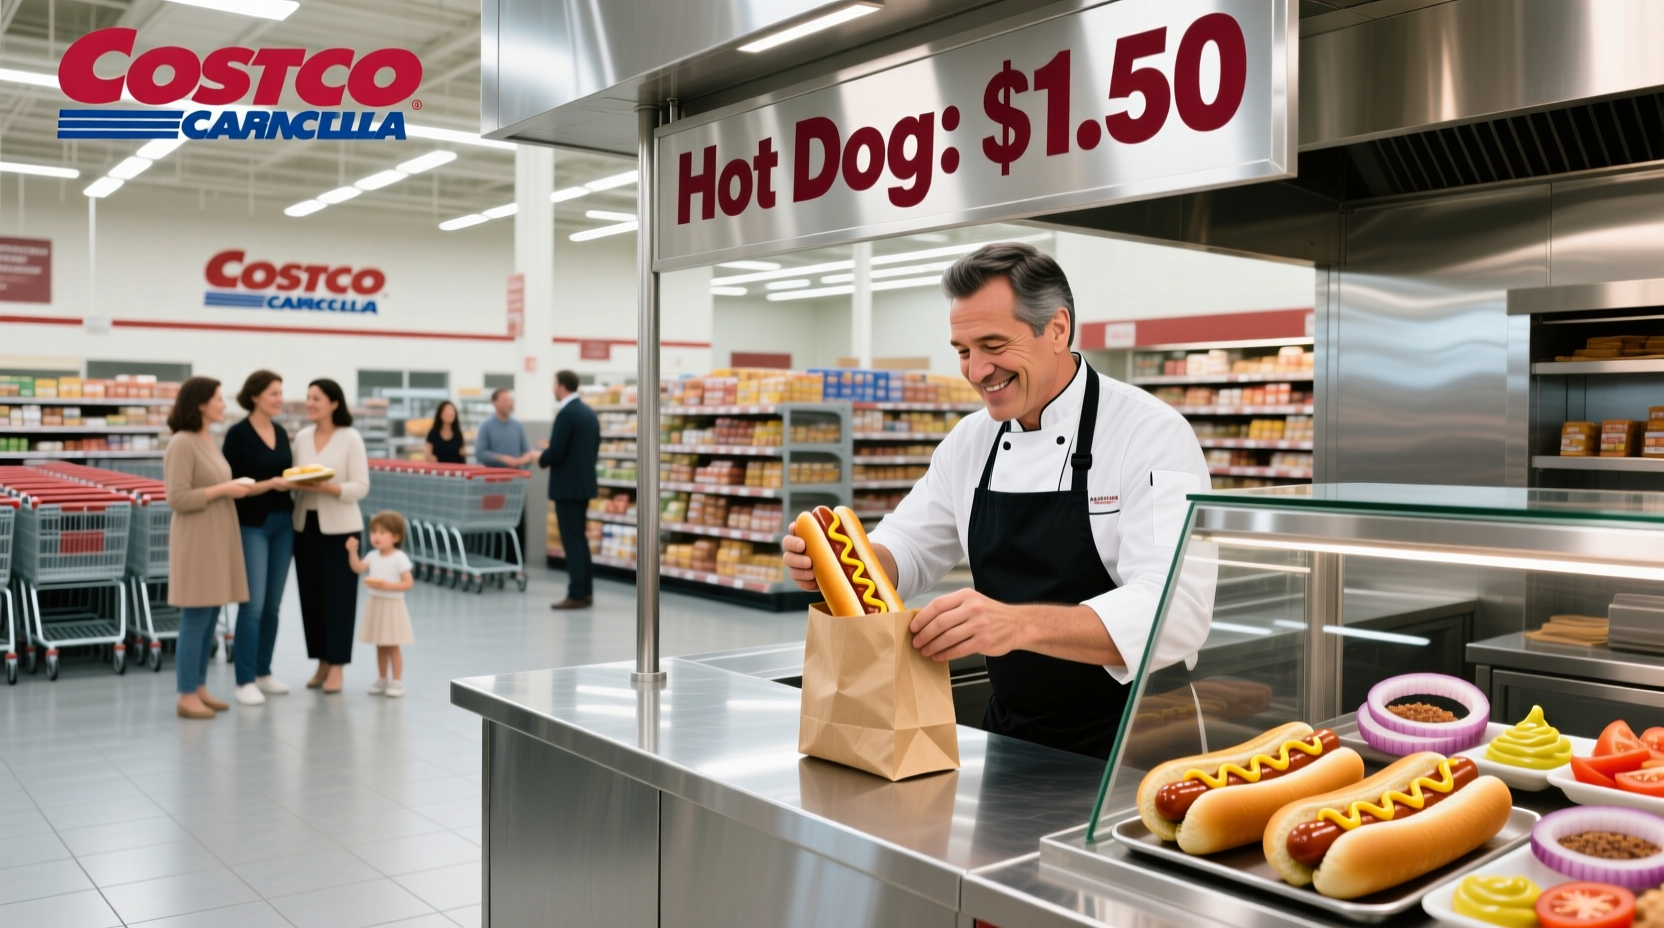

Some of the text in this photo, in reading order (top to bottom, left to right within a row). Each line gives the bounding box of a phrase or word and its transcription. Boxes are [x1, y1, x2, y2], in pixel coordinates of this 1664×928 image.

[677, 12, 1247, 225] Hot Dog: $1.50
[205, 249, 385, 295] COSTCO
